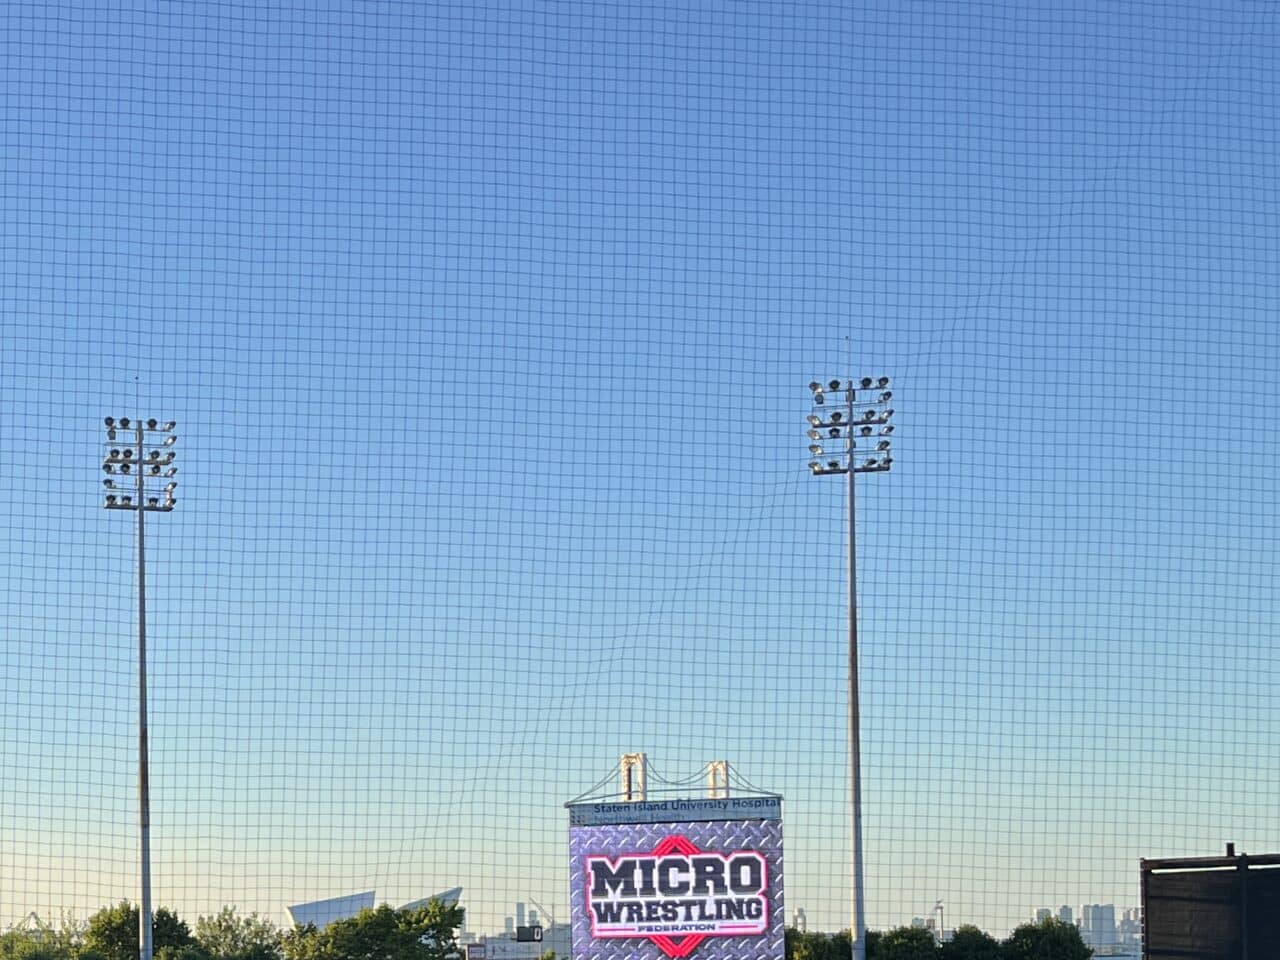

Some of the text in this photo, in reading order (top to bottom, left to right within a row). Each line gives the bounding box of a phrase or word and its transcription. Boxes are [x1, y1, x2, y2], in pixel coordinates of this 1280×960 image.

[594, 798, 781, 813] Staten Island University Hospital
[590, 858, 763, 898] MICRO
[592, 898, 764, 924] WRESTLING
[637, 923, 716, 932] FEDERATION
